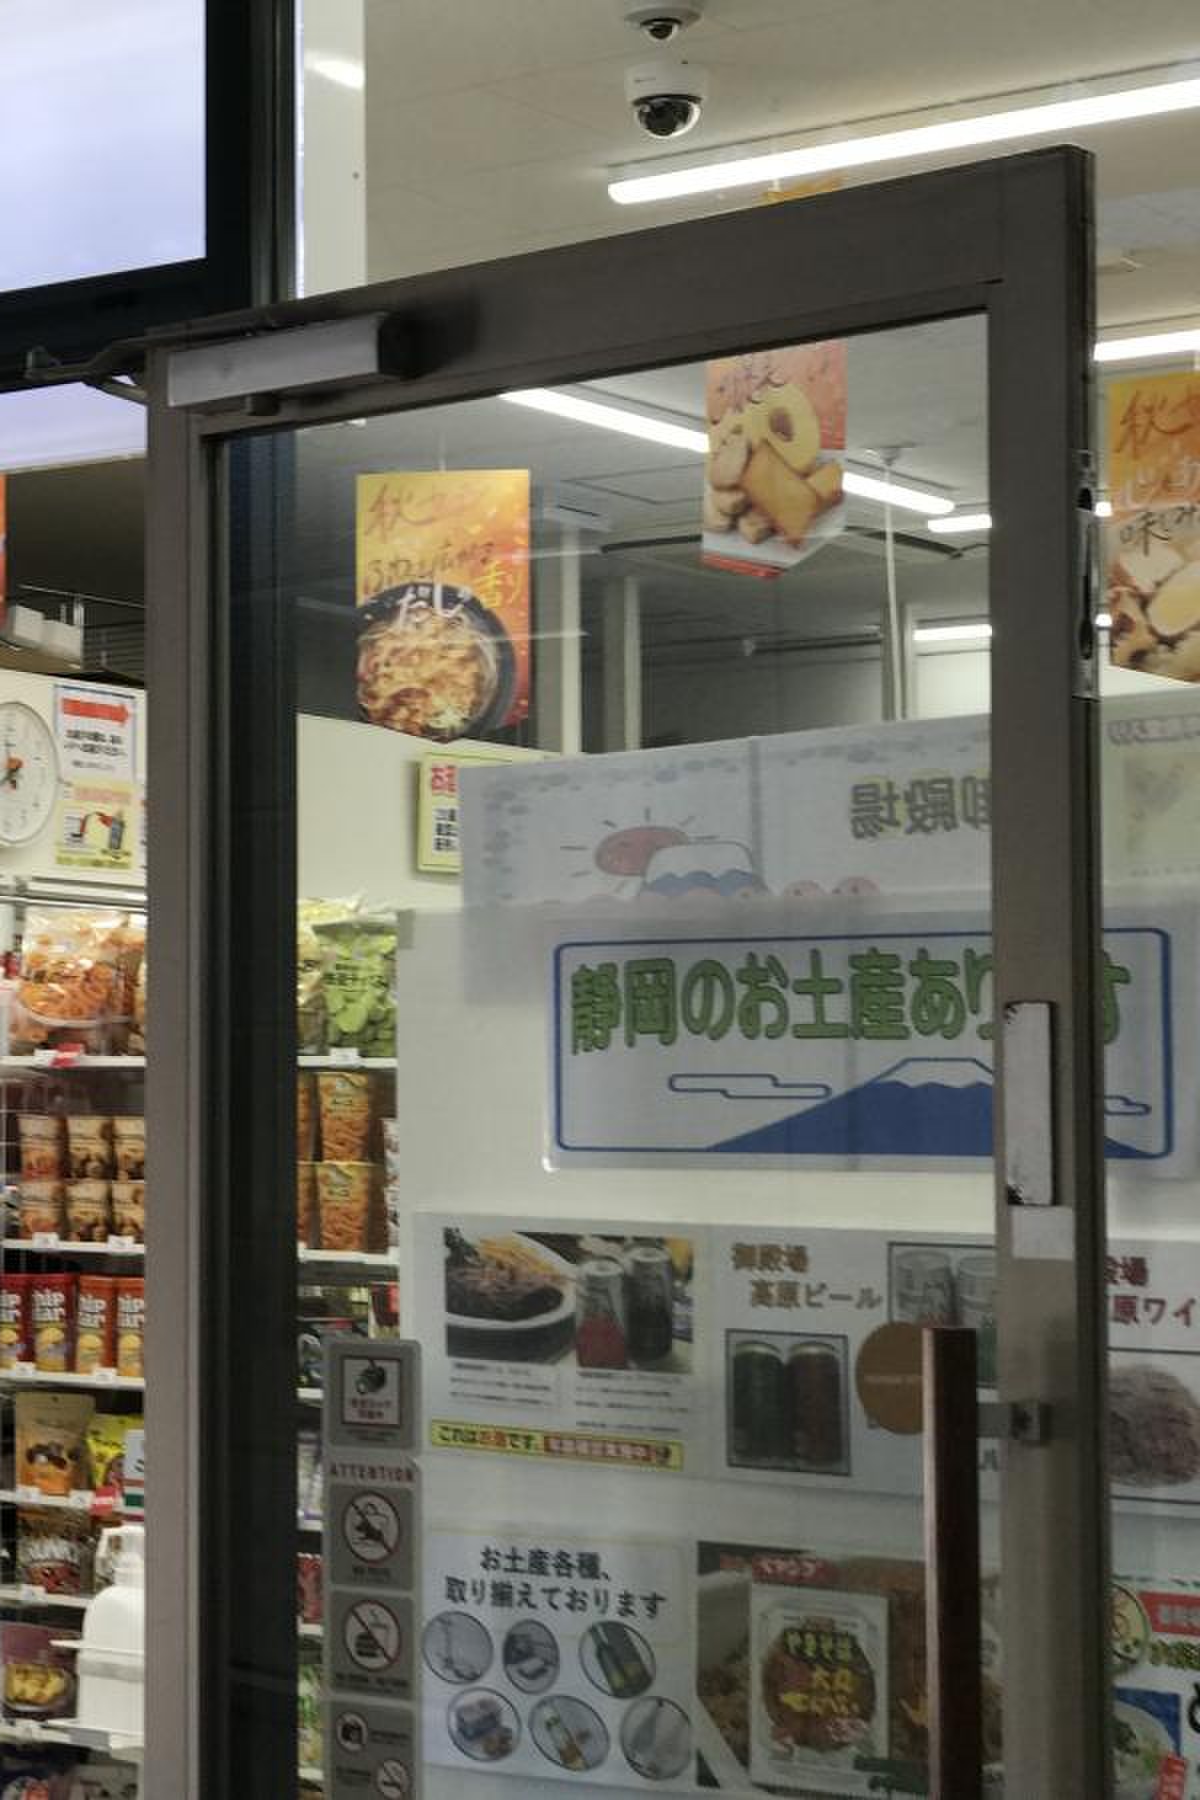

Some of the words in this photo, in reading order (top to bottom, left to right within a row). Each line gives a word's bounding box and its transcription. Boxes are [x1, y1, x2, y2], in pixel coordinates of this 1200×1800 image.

[571, 947, 1131, 1056] 静岡のお土産あり
[750, 1279, 883, 1312] 高原ビール
[330, 1463, 414, 1482] ATTENTION
[445, 1576, 667, 1619] 取り揃えております
